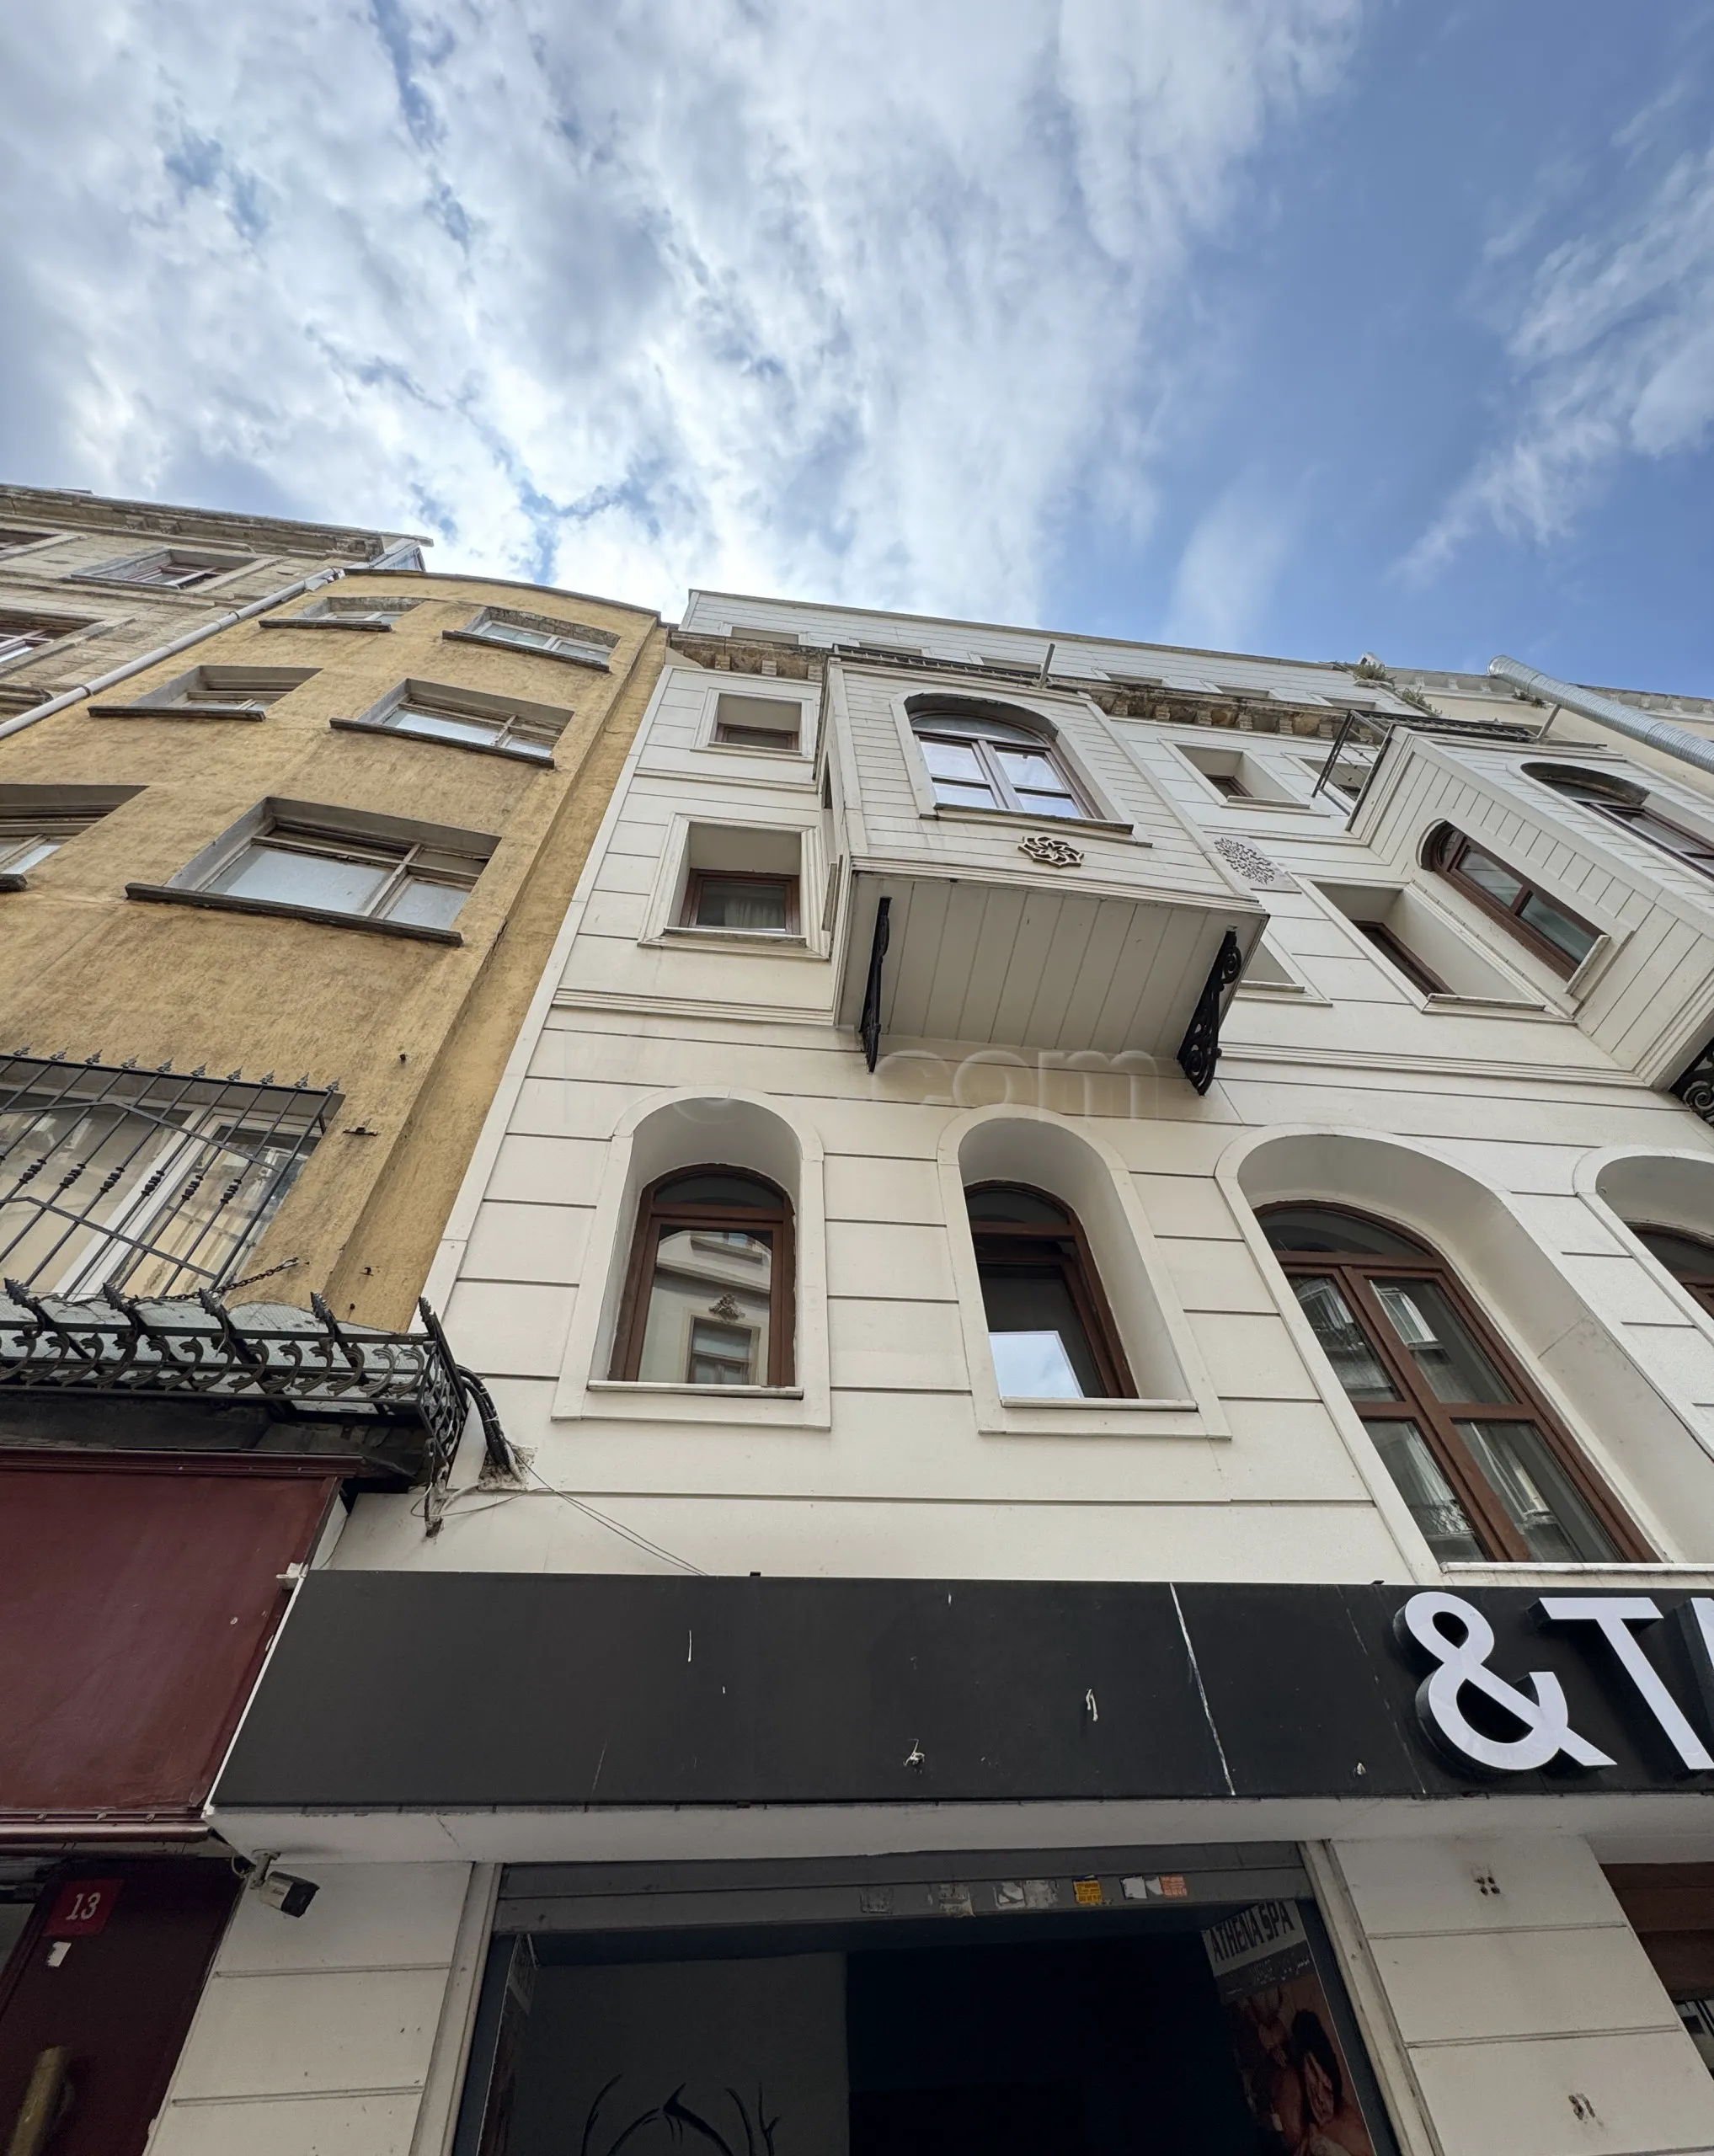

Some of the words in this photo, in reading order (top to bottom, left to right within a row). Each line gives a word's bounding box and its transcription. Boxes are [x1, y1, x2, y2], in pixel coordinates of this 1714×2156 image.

[1403, 1590, 1618, 1771] &
[1538, 1597, 1714, 1771] T
[65, 1892, 101, 1921] 13
[1209, 1908, 1265, 1963] ATHENA
[1257, 1900, 1295, 1941] SPA
